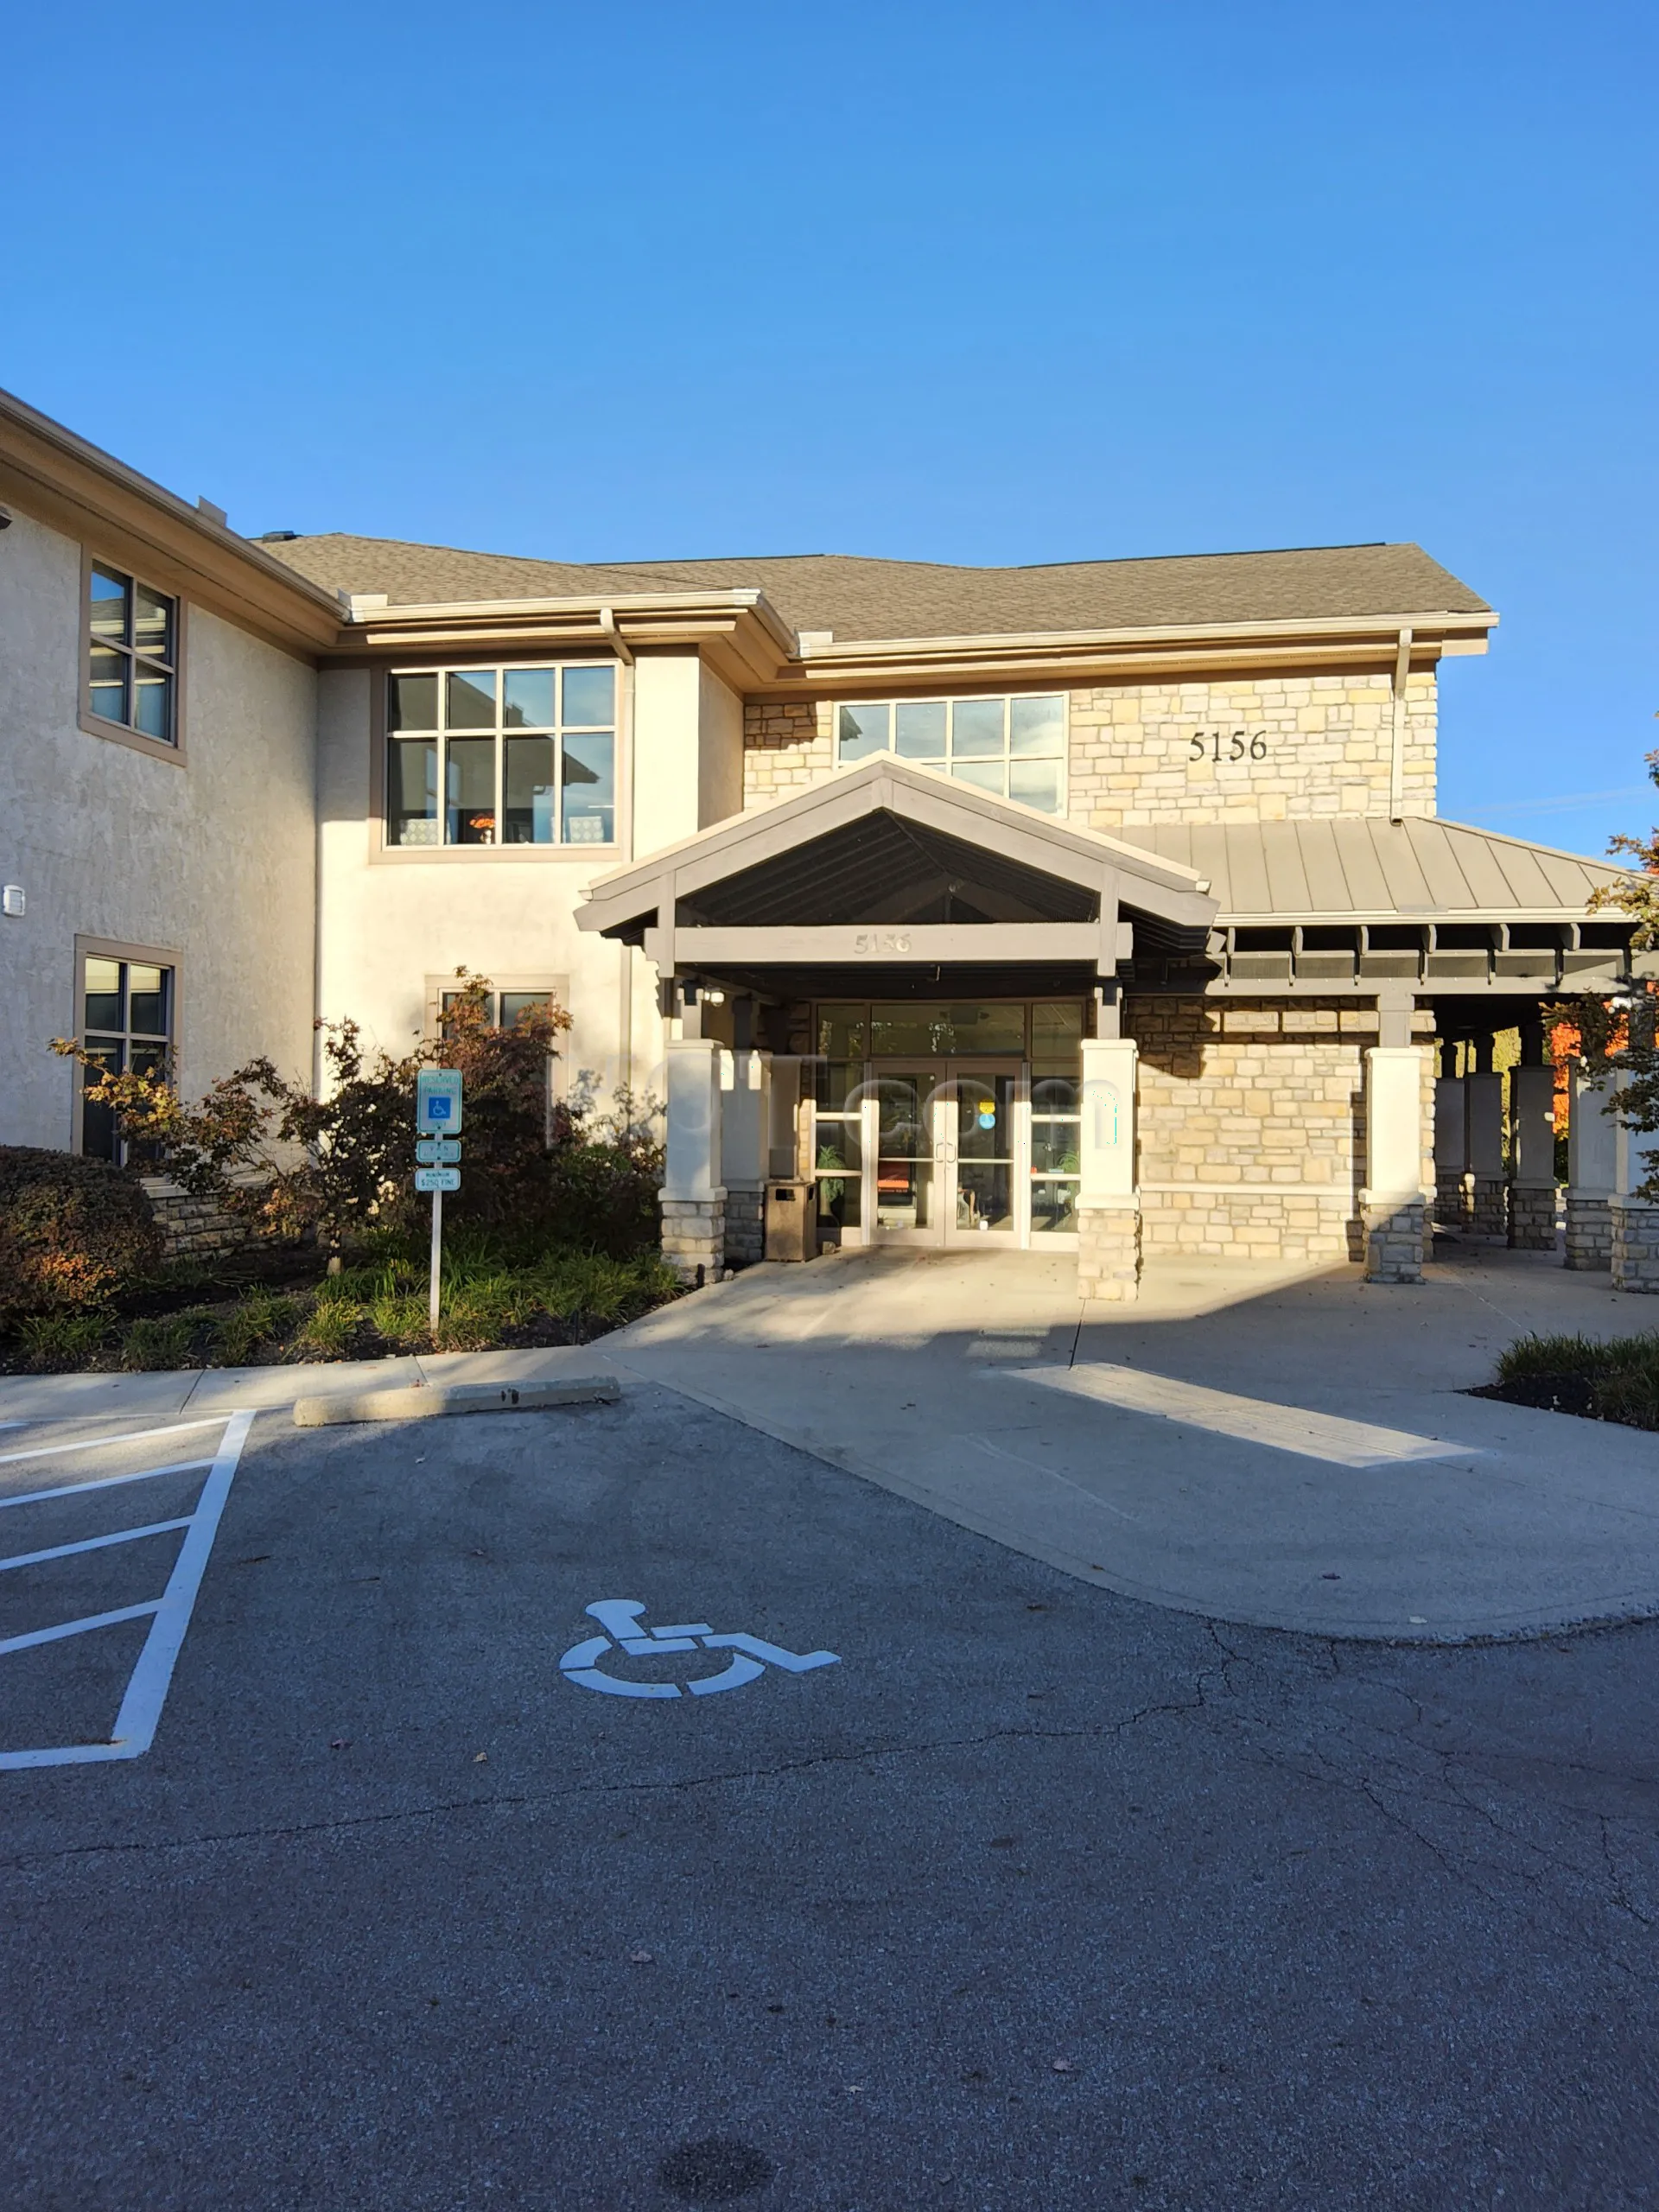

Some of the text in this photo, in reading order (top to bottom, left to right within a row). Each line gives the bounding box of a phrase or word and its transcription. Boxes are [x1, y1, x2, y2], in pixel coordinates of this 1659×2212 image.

[1189, 730, 1267, 762] 5156
[854, 933, 912, 955] 5156
[422, 1076, 458, 1084] RESERVED
